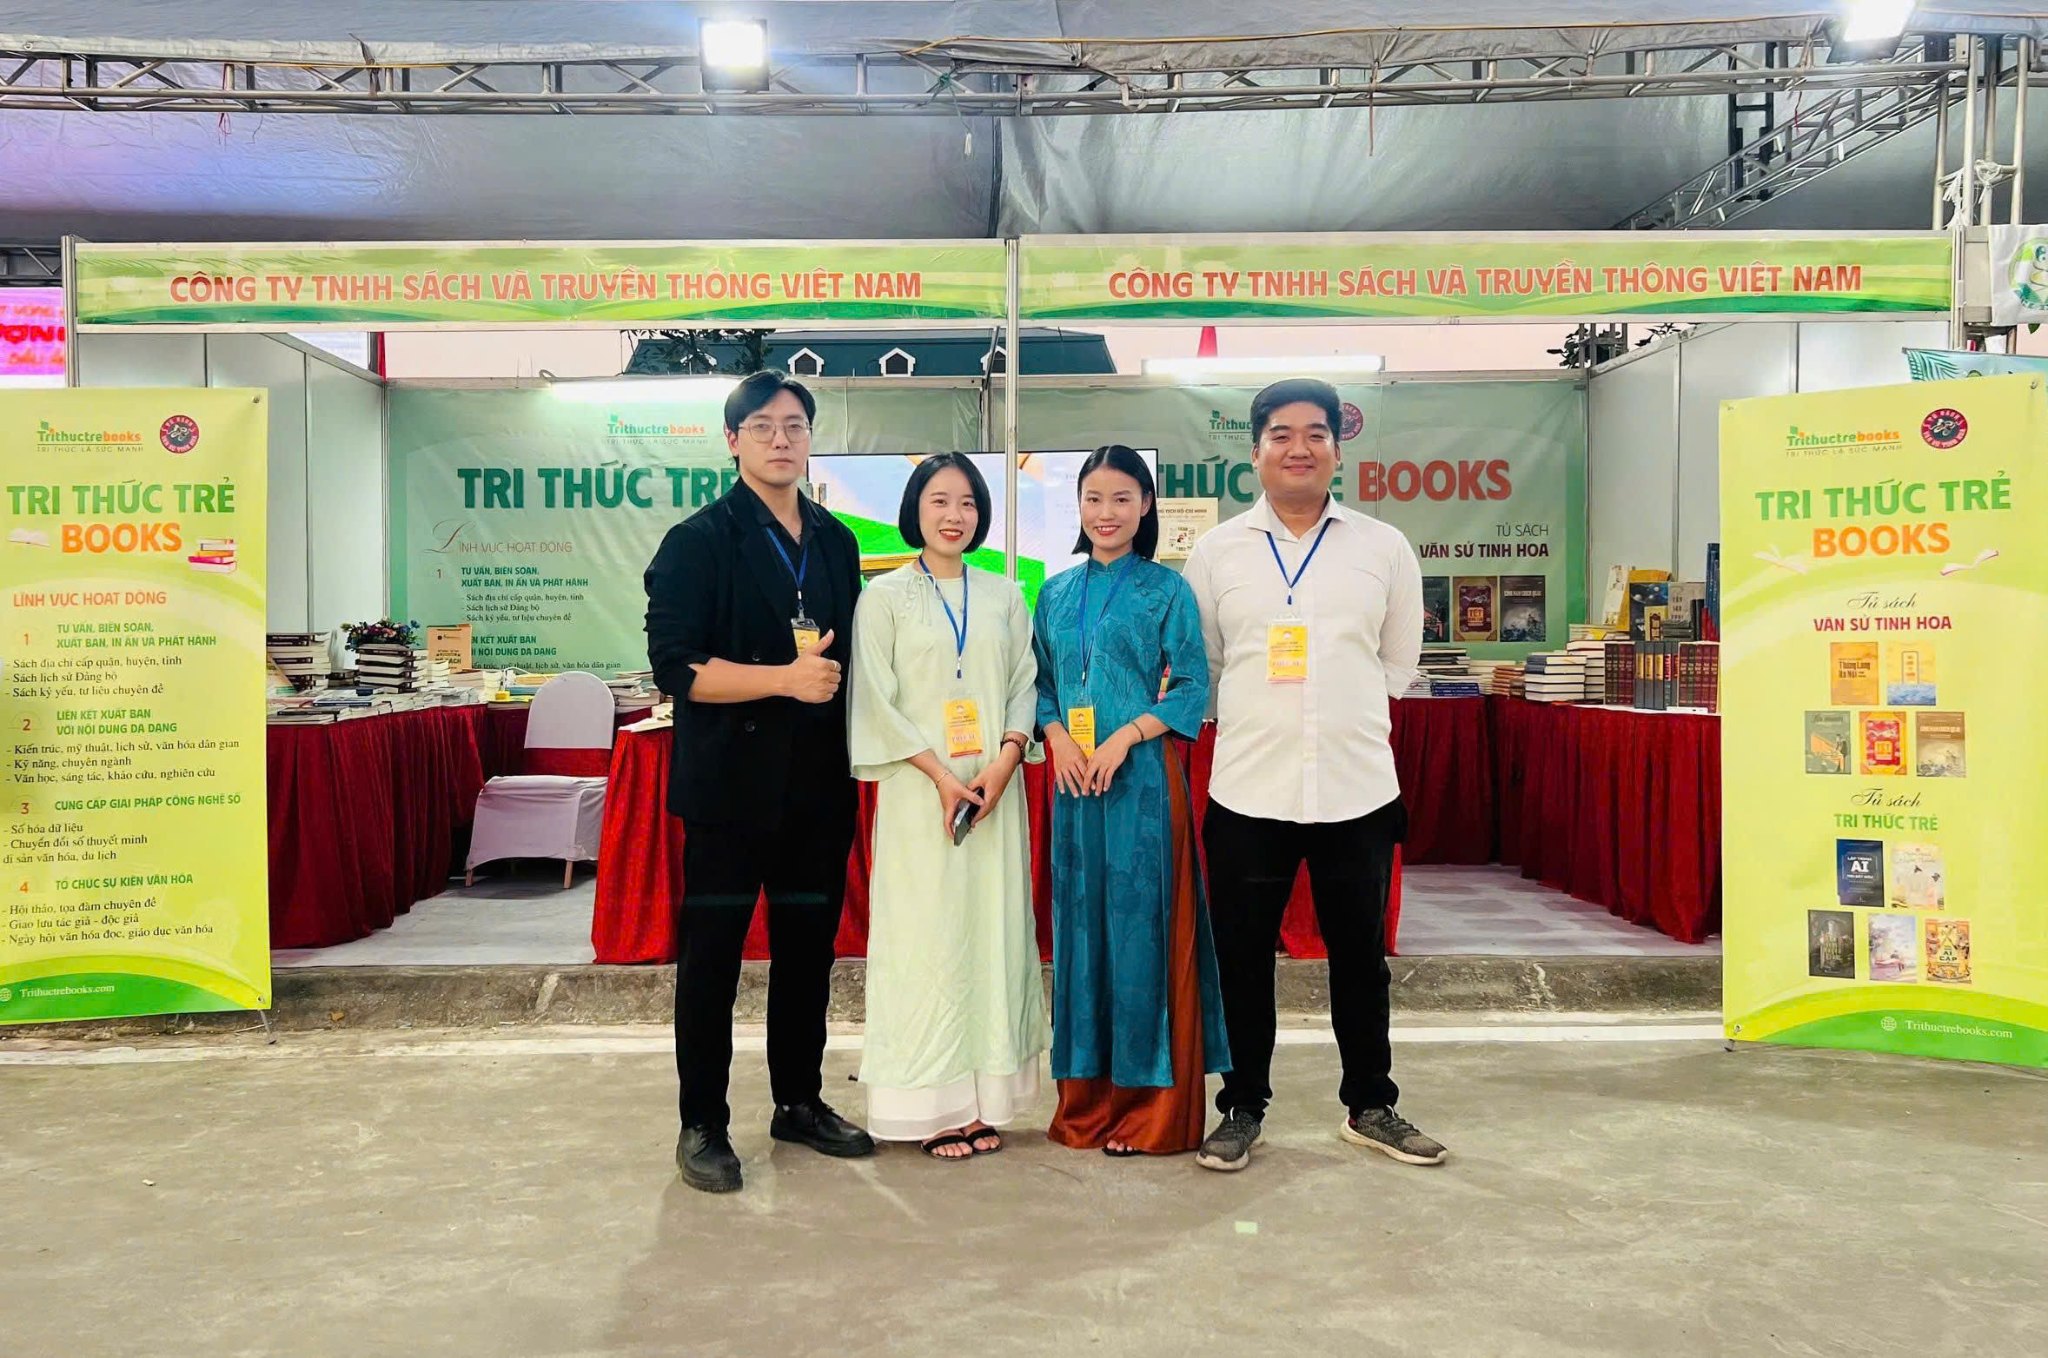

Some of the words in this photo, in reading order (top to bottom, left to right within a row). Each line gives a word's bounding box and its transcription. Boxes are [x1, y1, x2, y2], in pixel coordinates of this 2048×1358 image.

[169, 271, 256, 302] CÔNG
[265, 275, 302, 301] TY
[312, 275, 392, 301] TNHH
[403, 269, 481, 300] SÁCH
[491, 269, 532, 300] VÀ
[541, 265, 656, 299] TRUYỀN
[669, 266, 771, 299] THÔNG
[781, 265, 845, 302] VIỆT
[854, 272, 921, 298] NAM
[1108, 266, 1193, 298] CÔNG
[1202, 271, 1240, 297] TY
[1248, 270, 1328, 297] TNHH
[1339, 264, 1416, 296] SÁCH
[1426, 263, 1467, 295] VÀ
[1476, 258, 1592, 295] TRUYỀN
[1602, 261, 1708, 294] THÔNG
[1718, 259, 1782, 296] VIỆT
[1793, 265, 1861, 292] NAM
[457, 467, 524, 509] TRI
[538, 461, 653, 509] THỨC
[1158, 455, 1254, 502] HỨC
[1358, 460, 1512, 501] BOOKS
[6, 485, 60, 515] TRI
[72, 479, 162, 514] THỨC
[174, 476, 235, 513] TRẺ
[1755, 489, 1811, 521] TRI
[1823, 478, 1926, 518] THỨC
[1939, 470, 2011, 513] TRẺ
[61, 522, 182, 553] BOOKS
[1496, 522, 1512, 537] TỦ
[1812, 522, 1950, 558] BOOKS
[1419, 542, 1449, 558] VĂN
[1478, 544, 1511, 558] TINH
[1517, 543, 1549, 557] HOA
[1874, 617, 1911, 630] TINH
[1916, 616, 1952, 630] HOA
[22, 719, 31, 731] 2
[20, 802, 30, 815] 3
[1834, 813, 1858, 828] TRI
[121, 834, 148, 845] minh
[82, 851, 94, 861] du
[1851, 860, 1869, 873] AI
[19, 881, 29, 893] 4
[19, 984, 115, 998] Trithuctrebooks.com
[1905, 1020, 2013, 1039] Trithuctrebooks.com
